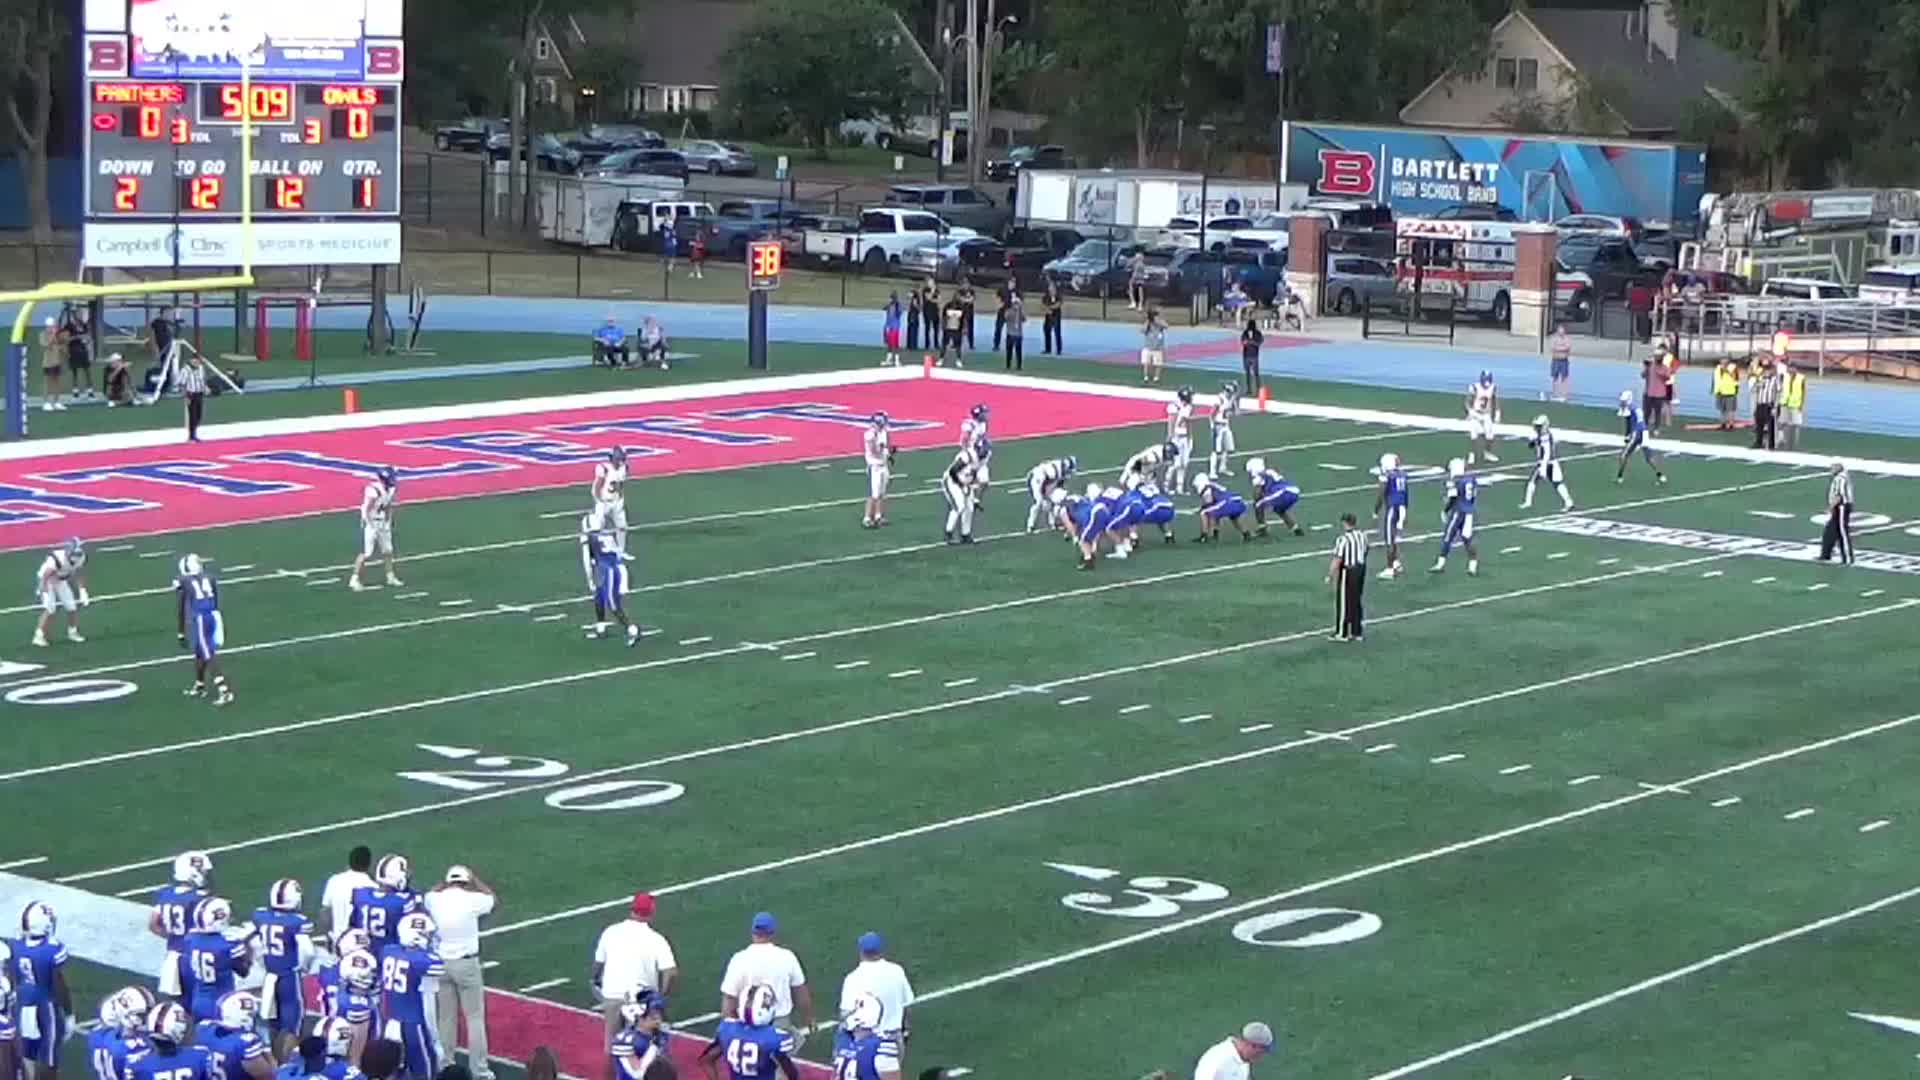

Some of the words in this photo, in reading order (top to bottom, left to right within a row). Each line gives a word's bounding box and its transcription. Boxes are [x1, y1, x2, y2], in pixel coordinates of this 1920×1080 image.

[96, 84, 185, 103] PANTHERS
[322, 87, 378, 105] OWLS
[140, 106, 162, 138] 0
[170, 118, 189, 144] 3
[303, 118, 322, 144] 3
[348, 107, 370, 139] 0
[99, 159, 154, 175] DOWN
[175, 159, 197, 175] TO
[201, 159, 226, 175] GO
[249, 159, 292, 175] BALL
[297, 159, 324, 175] ON
[342, 159, 383, 176] QTR.
[1317, 148, 1376, 195] B
[1391, 156, 1500, 182] BARTLETT
[115, 177, 138, 210] 2
[191, 177, 220, 210] 12
[275, 177, 304, 209] 12
[363, 177, 373, 208] 1
[1391, 181, 1416, 198] HIGH
[1420, 182, 1462, 200] SCHOOL
[1467, 185, 1497, 203] BAND
[96, 237, 162, 257] Campbell
[257, 239, 315, 251] SPORTS
[319, 238, 393, 251] MEDICINE
[753, 245, 781, 276] 38
[191, 576, 214, 601] 14
[361, 904, 387, 938] 12
[260, 924, 286, 957] 15
[190, 949, 217, 983] 46
[382, 955, 410, 994] 85
[726, 1038, 760, 1076] 42
